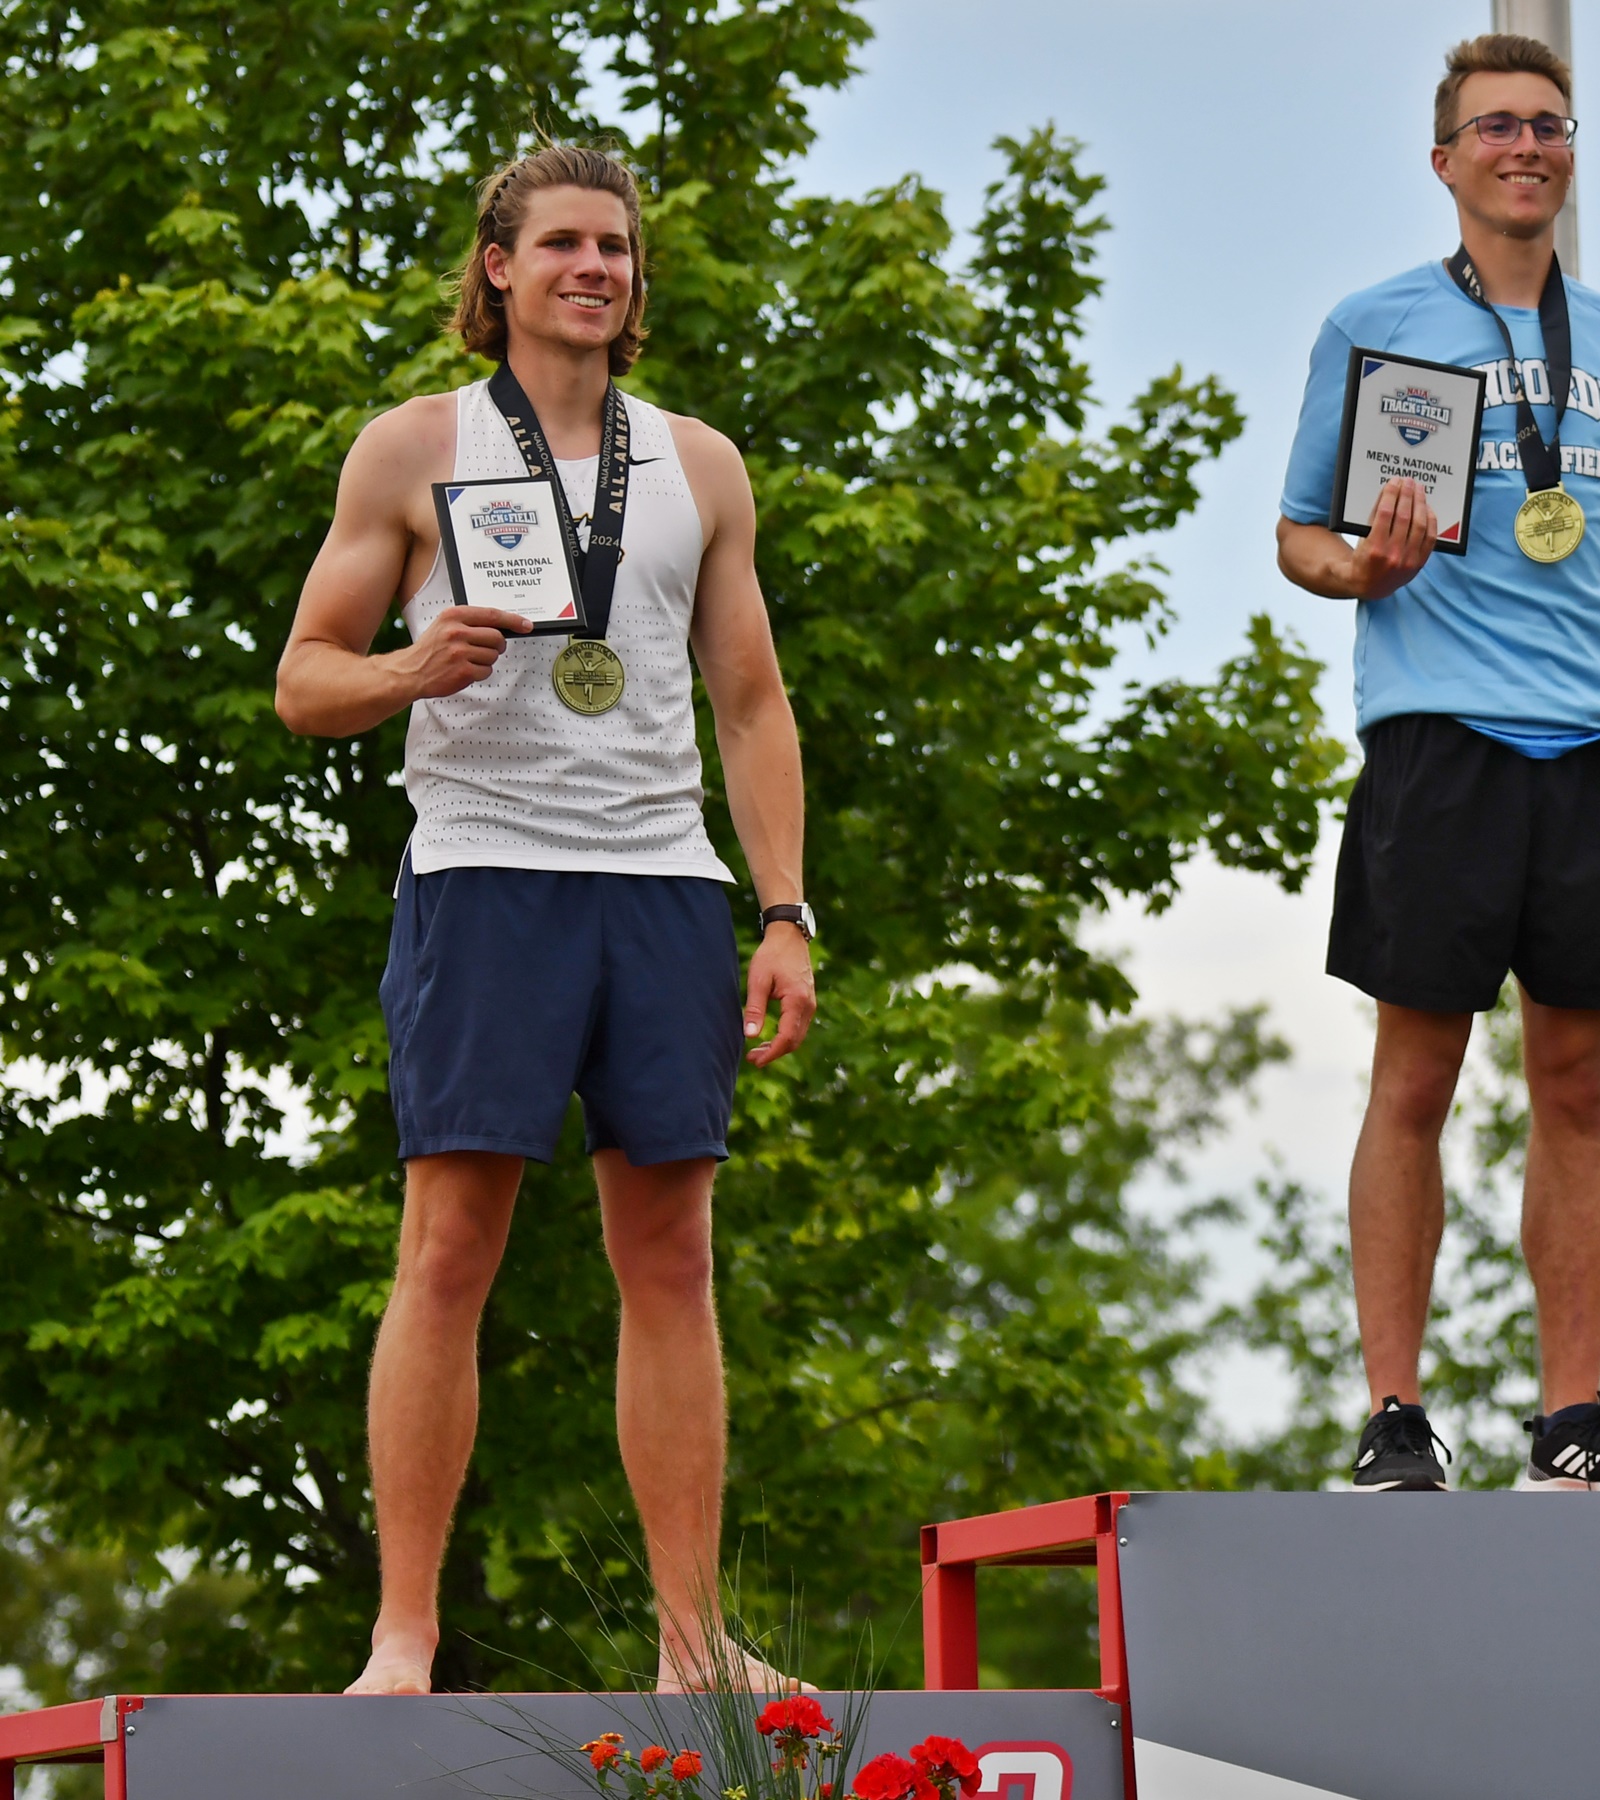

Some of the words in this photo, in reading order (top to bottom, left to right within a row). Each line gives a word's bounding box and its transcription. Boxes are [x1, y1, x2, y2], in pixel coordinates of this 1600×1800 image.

[1408, 388, 1429, 397] NAIA
[606, 401, 615, 426] TRACK
[1382, 397, 1416, 414] TRACK
[1420, 404, 1450, 424] FIELD
[1391, 417, 1437, 431] CHAMPIONSHIPS
[531, 431, 545, 453] NAIA
[602, 426, 612, 467] OUTDOOR
[1366, 450, 1400, 465] MEN'S
[1402, 457, 1454, 475] NATIONAL
[601, 467, 611, 488] NAIA
[1380, 465, 1437, 483] CHAMPION
[491, 501, 512, 509] NAIA
[471, 513, 502, 528] TRACK
[508, 511, 537, 525] FIELD
[591, 534, 620, 548] 2024
[473, 560, 504, 570] MEN'S
[506, 557, 553, 568] NATIONAL
[486, 567, 543, 578] RUNNER-UP
[492, 580, 514, 588] POLE
[516, 578, 541, 587] VAULT
